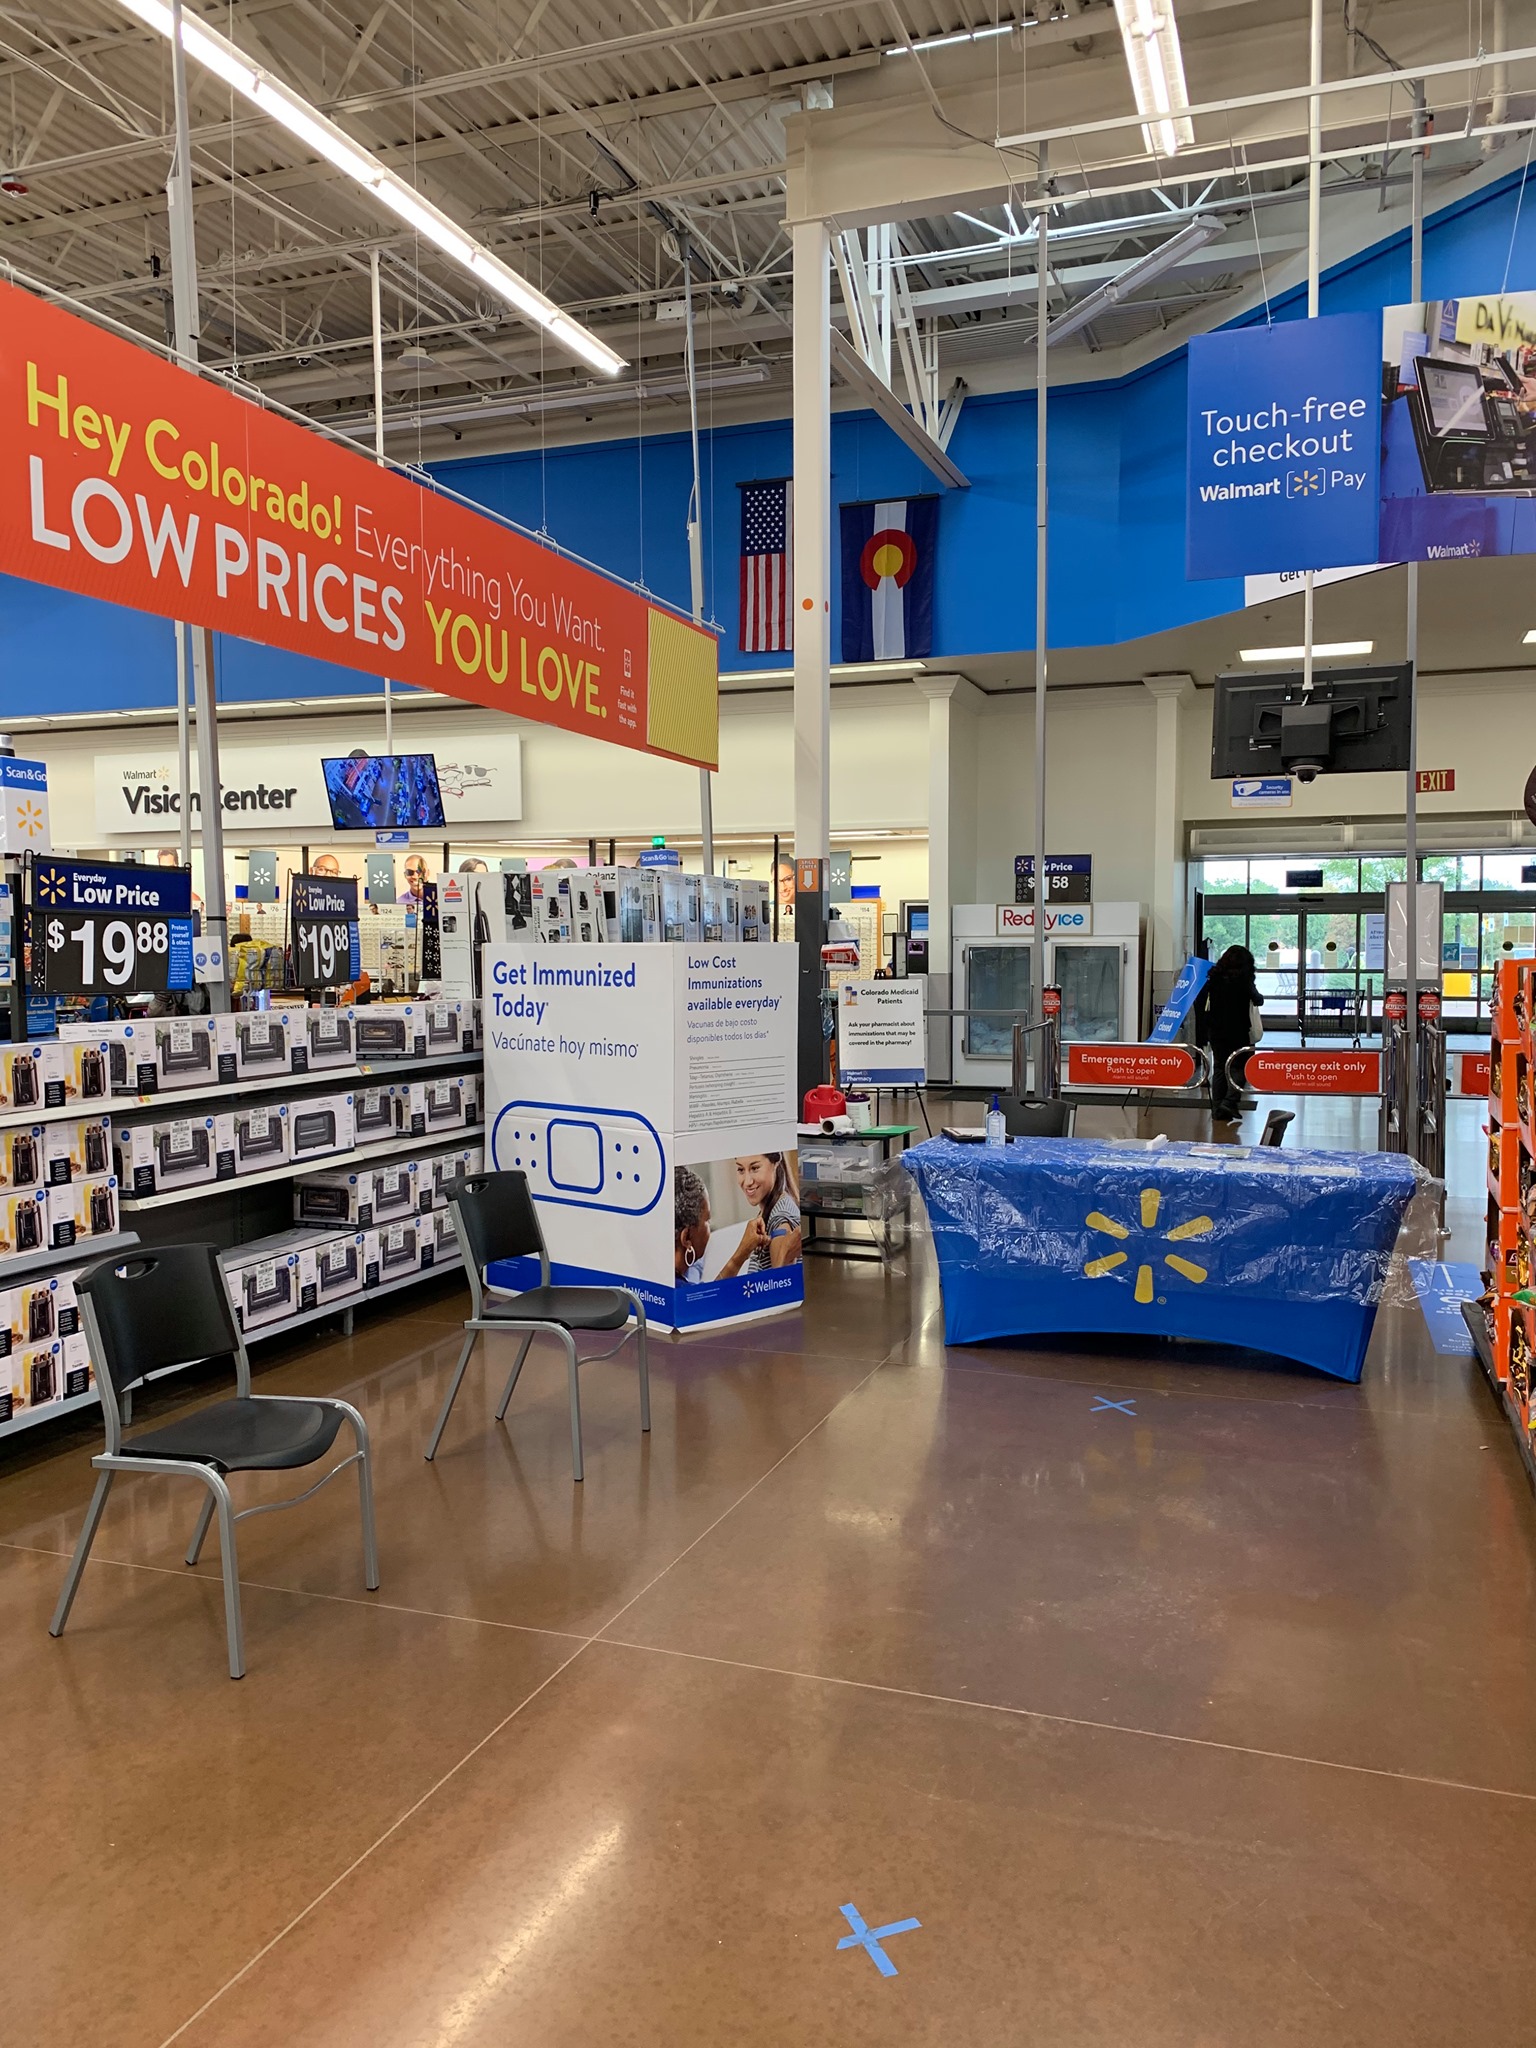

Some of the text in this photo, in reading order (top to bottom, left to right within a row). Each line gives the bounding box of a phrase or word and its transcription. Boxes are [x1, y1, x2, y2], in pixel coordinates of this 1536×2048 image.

[1201, 396, 1367, 437] Touch-free
[1212, 428, 1353, 467] checkout
[1200, 470, 1367, 502] Walmart Pay
[26, 361, 606, 653] Hey Colorado! Everything You Want.
[1426, 543, 1470, 559] Walmart
[29, 455, 608, 719] LOW PRICES YOU LOVE.
[123, 770, 157, 780] Walmart
[1420, 771, 1448, 792] EXIT
[122, 784, 297, 814] Vision enter
[1051, 862, 1073, 872] Price
[73, 872, 107, 885] Everyday
[73, 883, 160, 907] Low Price
[308, 894, 345, 911] Low Price
[688, 955, 737, 969] Low Cost
[493, 961, 636, 988] Get Immunized
[688, 976, 763, 990] Immunizations
[687, 996, 733, 1011] available
[877, 997, 903, 1005] Patients
[687, 1018, 758, 1029] Vacunas de bajo costo
[491, 1031, 555, 1053] Vacúnate
[559, 1034, 586, 1060] hoy
[687, 1033, 723, 1044] disponibles
[724, 1032, 743, 1041] todos
[744, 1031, 753, 1039] los
[1081, 1054, 1182, 1068] Emergency exit only
[1258, 1060, 1367, 1073] Emergency exit only
[1106, 1066, 1124, 1074] Push
[1136, 1068, 1155, 1076] open
[1285, 1072, 1304, 1080] Push
[1318, 1074, 1338, 1083] open
[754, 1277, 792, 1293] Wellness
[631, 1287, 666, 1307] Wellness
